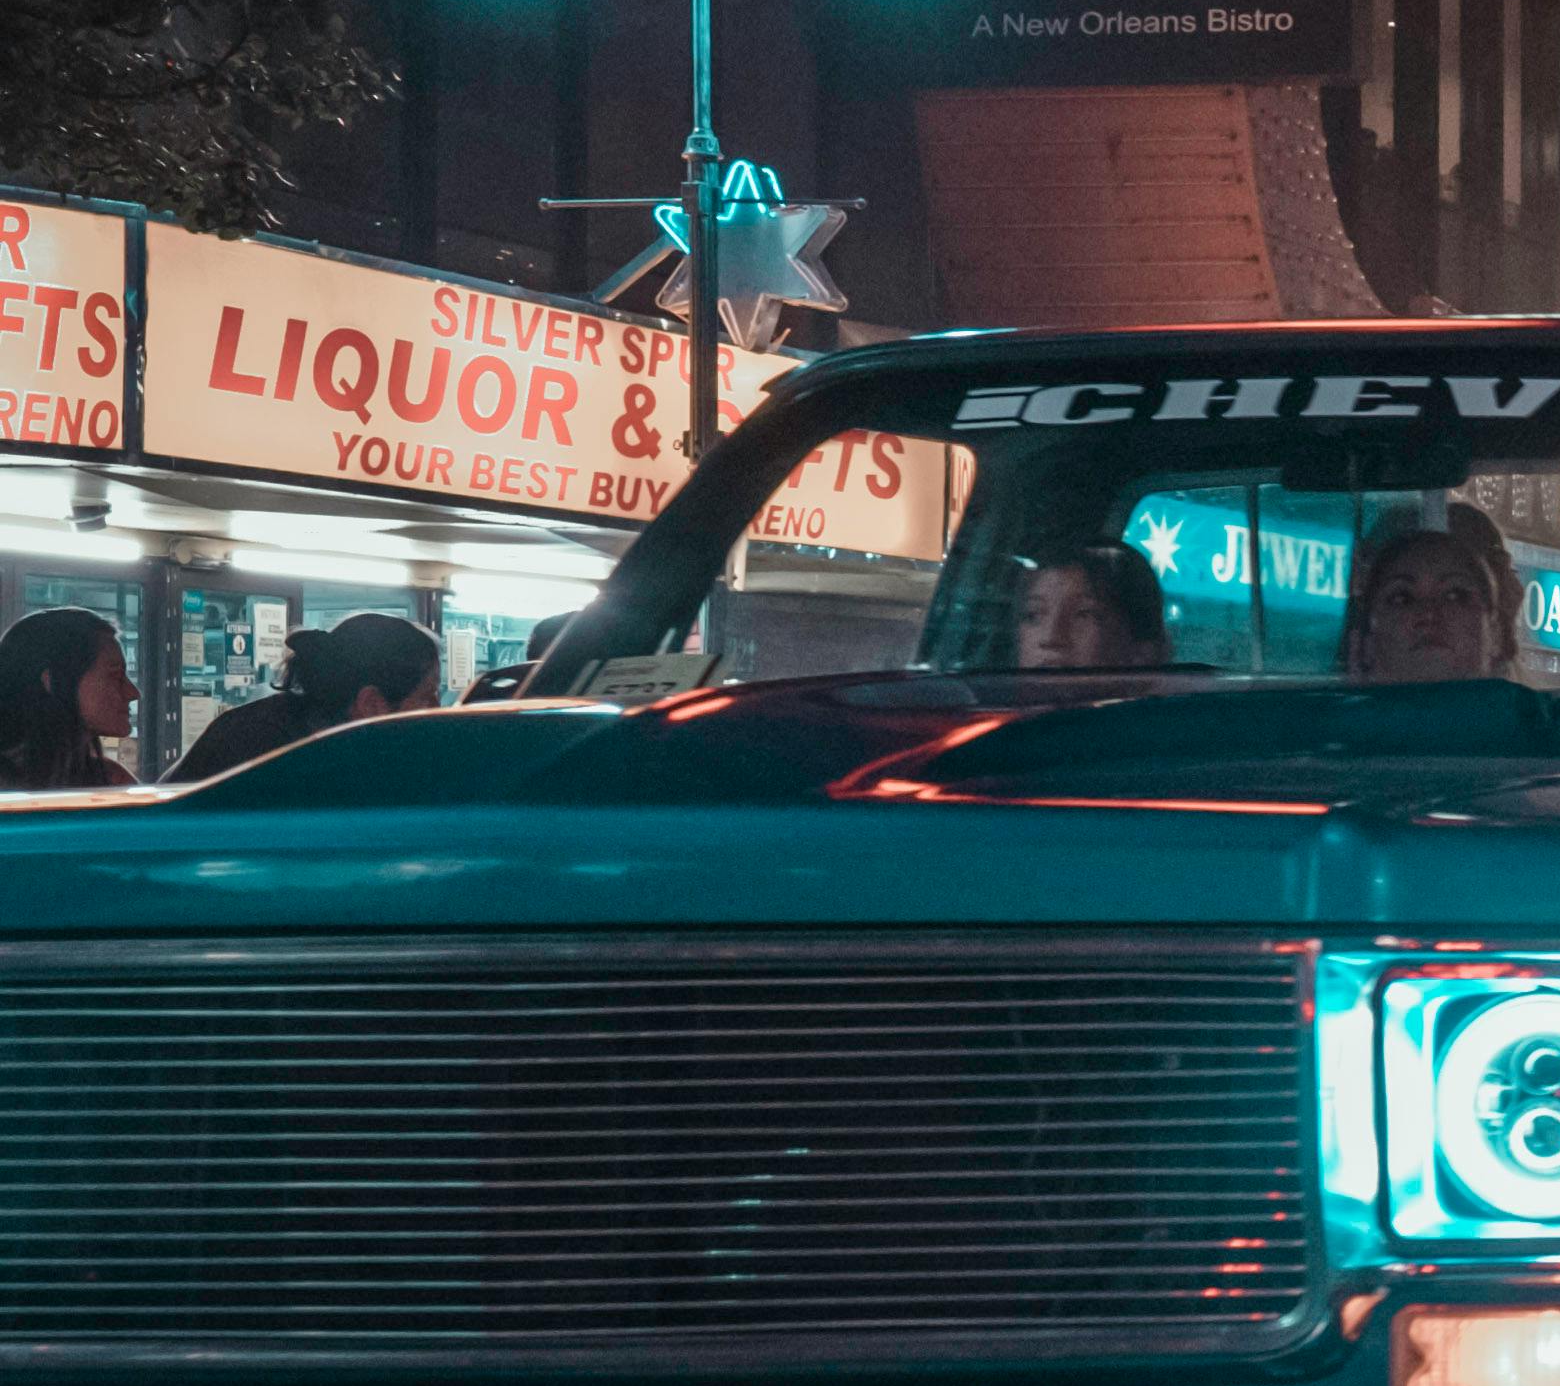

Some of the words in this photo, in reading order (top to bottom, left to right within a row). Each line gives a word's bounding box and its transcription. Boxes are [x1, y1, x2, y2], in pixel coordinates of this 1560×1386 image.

[972, 15, 994, 38] A
[1002, 14, 1069, 37] New
[1079, 8, 1197, 35] Orleans
[1207, 6, 1295, 34] Bistro
[431, 286, 605, 367] SILVER
[0, 390, 118, 448] RENO
[208, 305, 579, 447] LIQUOR
[611, 383, 662, 461] &
[332, 431, 455, 486] YOUR
[468, 453, 578, 501] BEST
[588, 471, 670, 514] BUY
